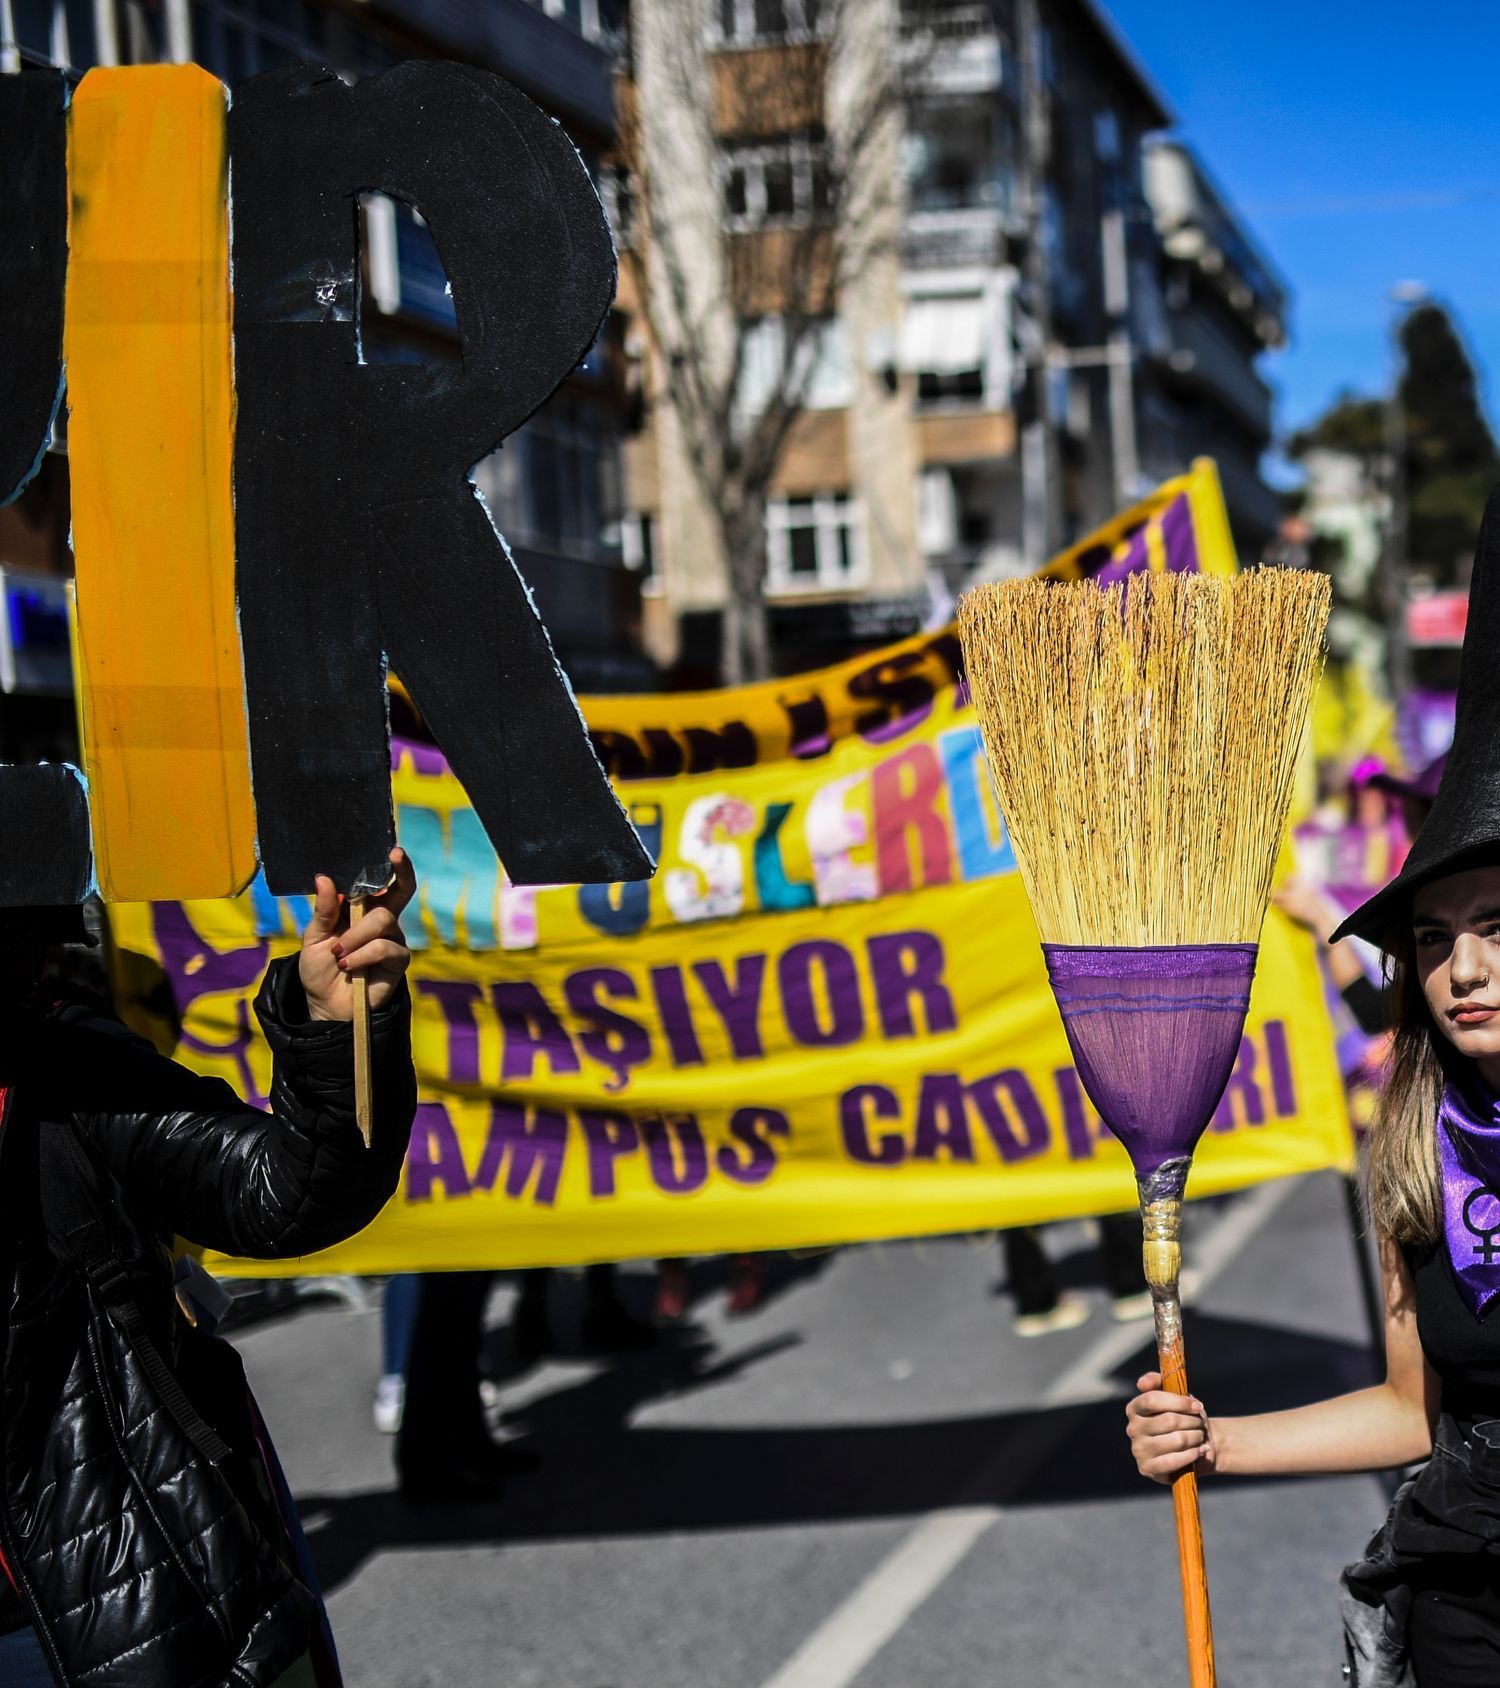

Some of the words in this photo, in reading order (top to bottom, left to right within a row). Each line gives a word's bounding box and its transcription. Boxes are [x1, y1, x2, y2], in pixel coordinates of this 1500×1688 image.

[0, 63, 657, 908] IR
[416, 930, 959, 1092] TAŞIYOR
[404, 1098, 792, 1207] AMPÜS
[839, 1020, 1298, 1166] CADIRI
